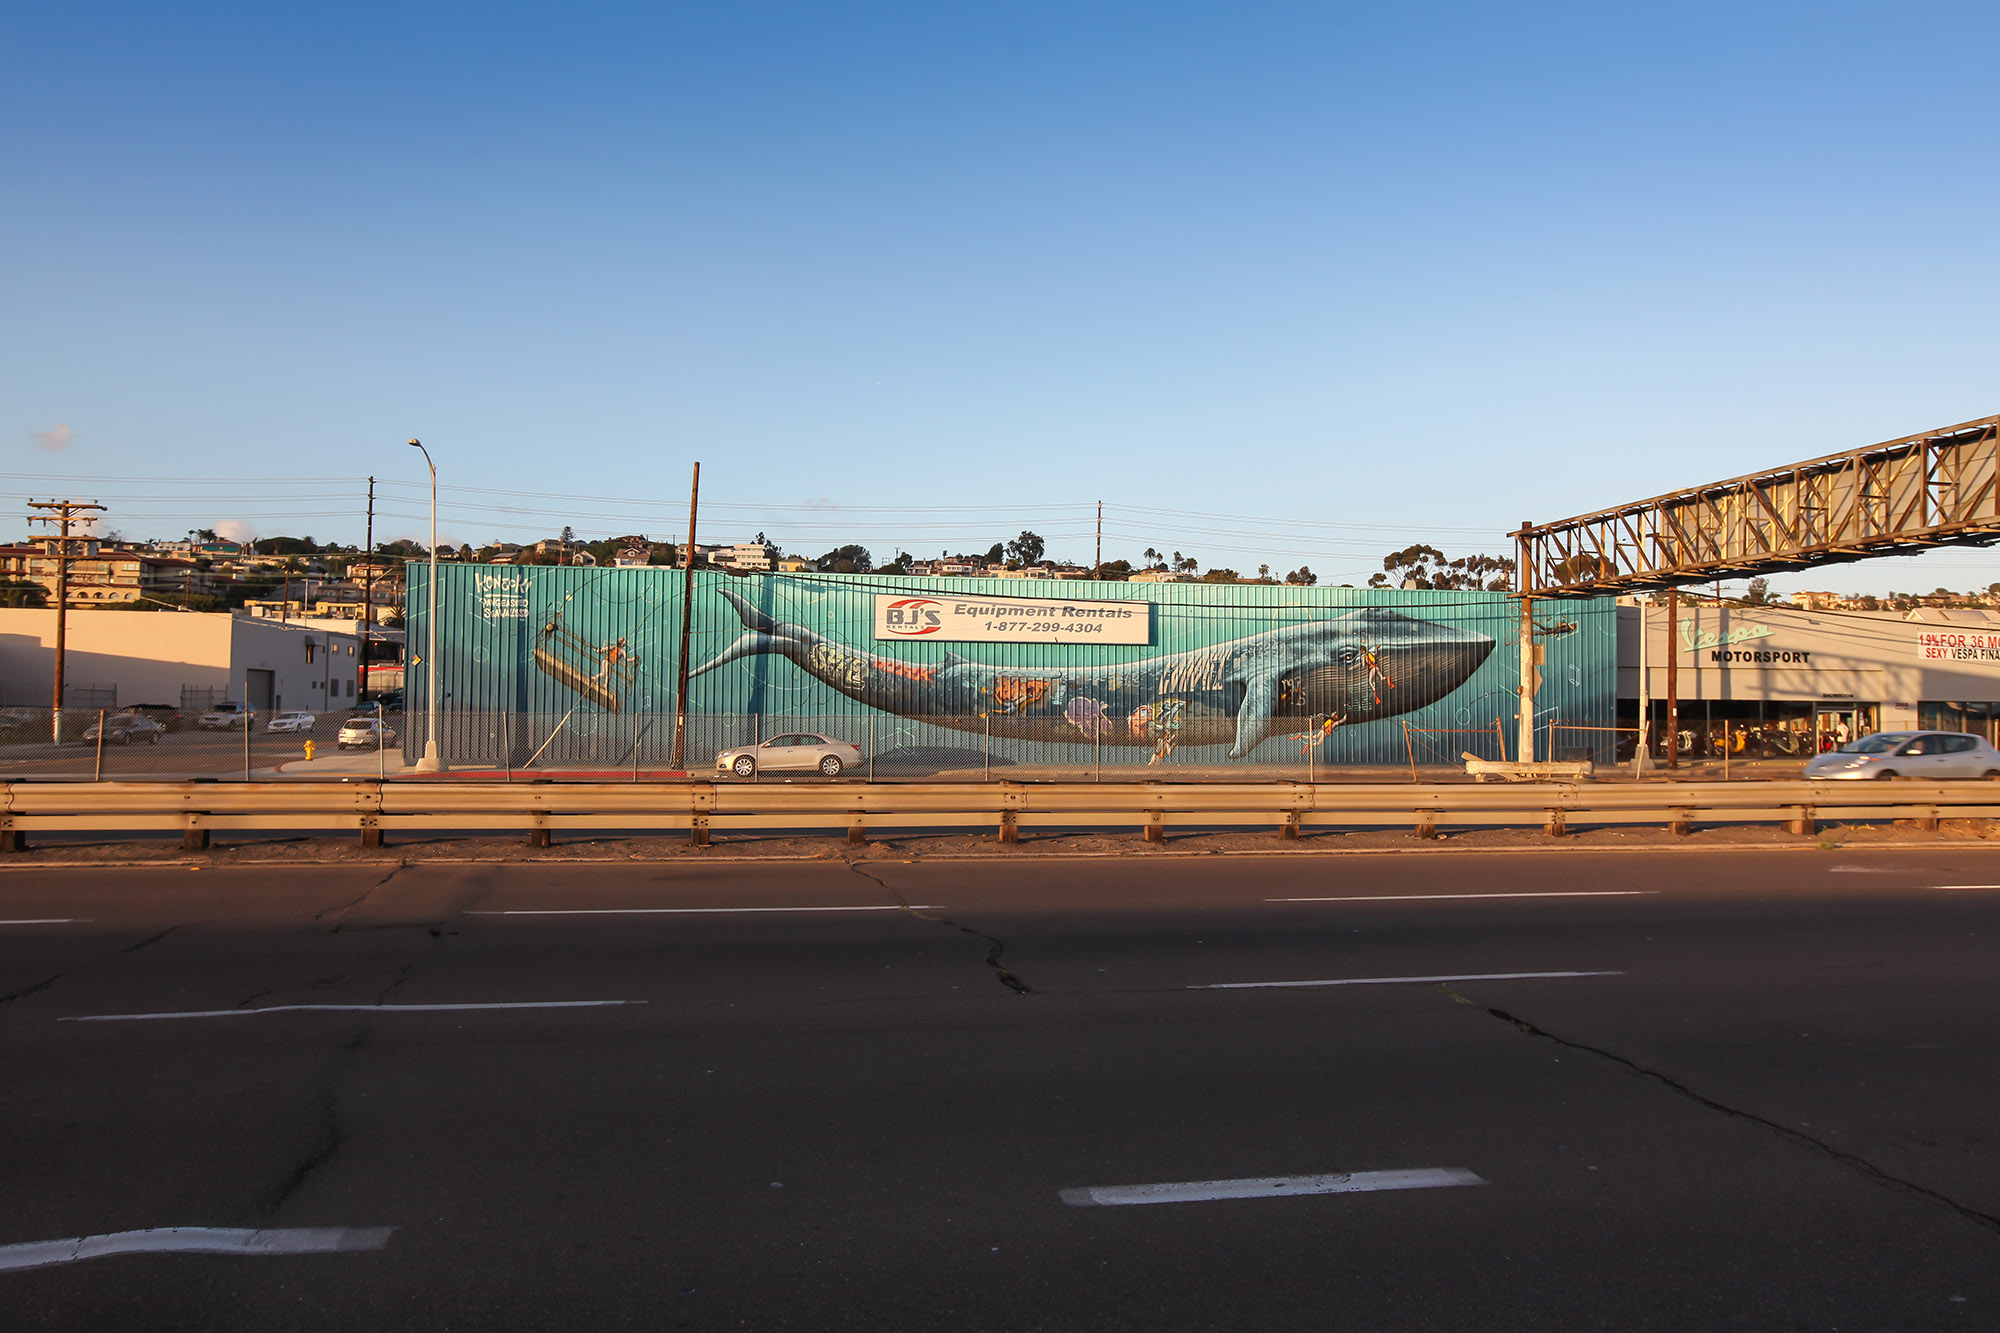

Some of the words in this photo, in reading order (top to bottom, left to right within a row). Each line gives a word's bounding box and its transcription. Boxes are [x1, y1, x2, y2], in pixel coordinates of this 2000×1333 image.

[886, 608, 942, 626] BJ'S
[954, 604, 1056, 618] Equipment
[1061, 606, 1133, 619] Rentals
[984, 621, 1103, 633] 1-877-299-4304
[1681, 616, 1776, 653] Vespa
[1940, 634, 1967, 648] FOR
[1970, 635, 1984, 648] 36
[1711, 650, 1810, 663] MOTORSPORT
[1926, 647, 1948, 659] SEXY
[1951, 648, 1978, 660] VESPA
[1980, 649, 2000, 661] FINA
